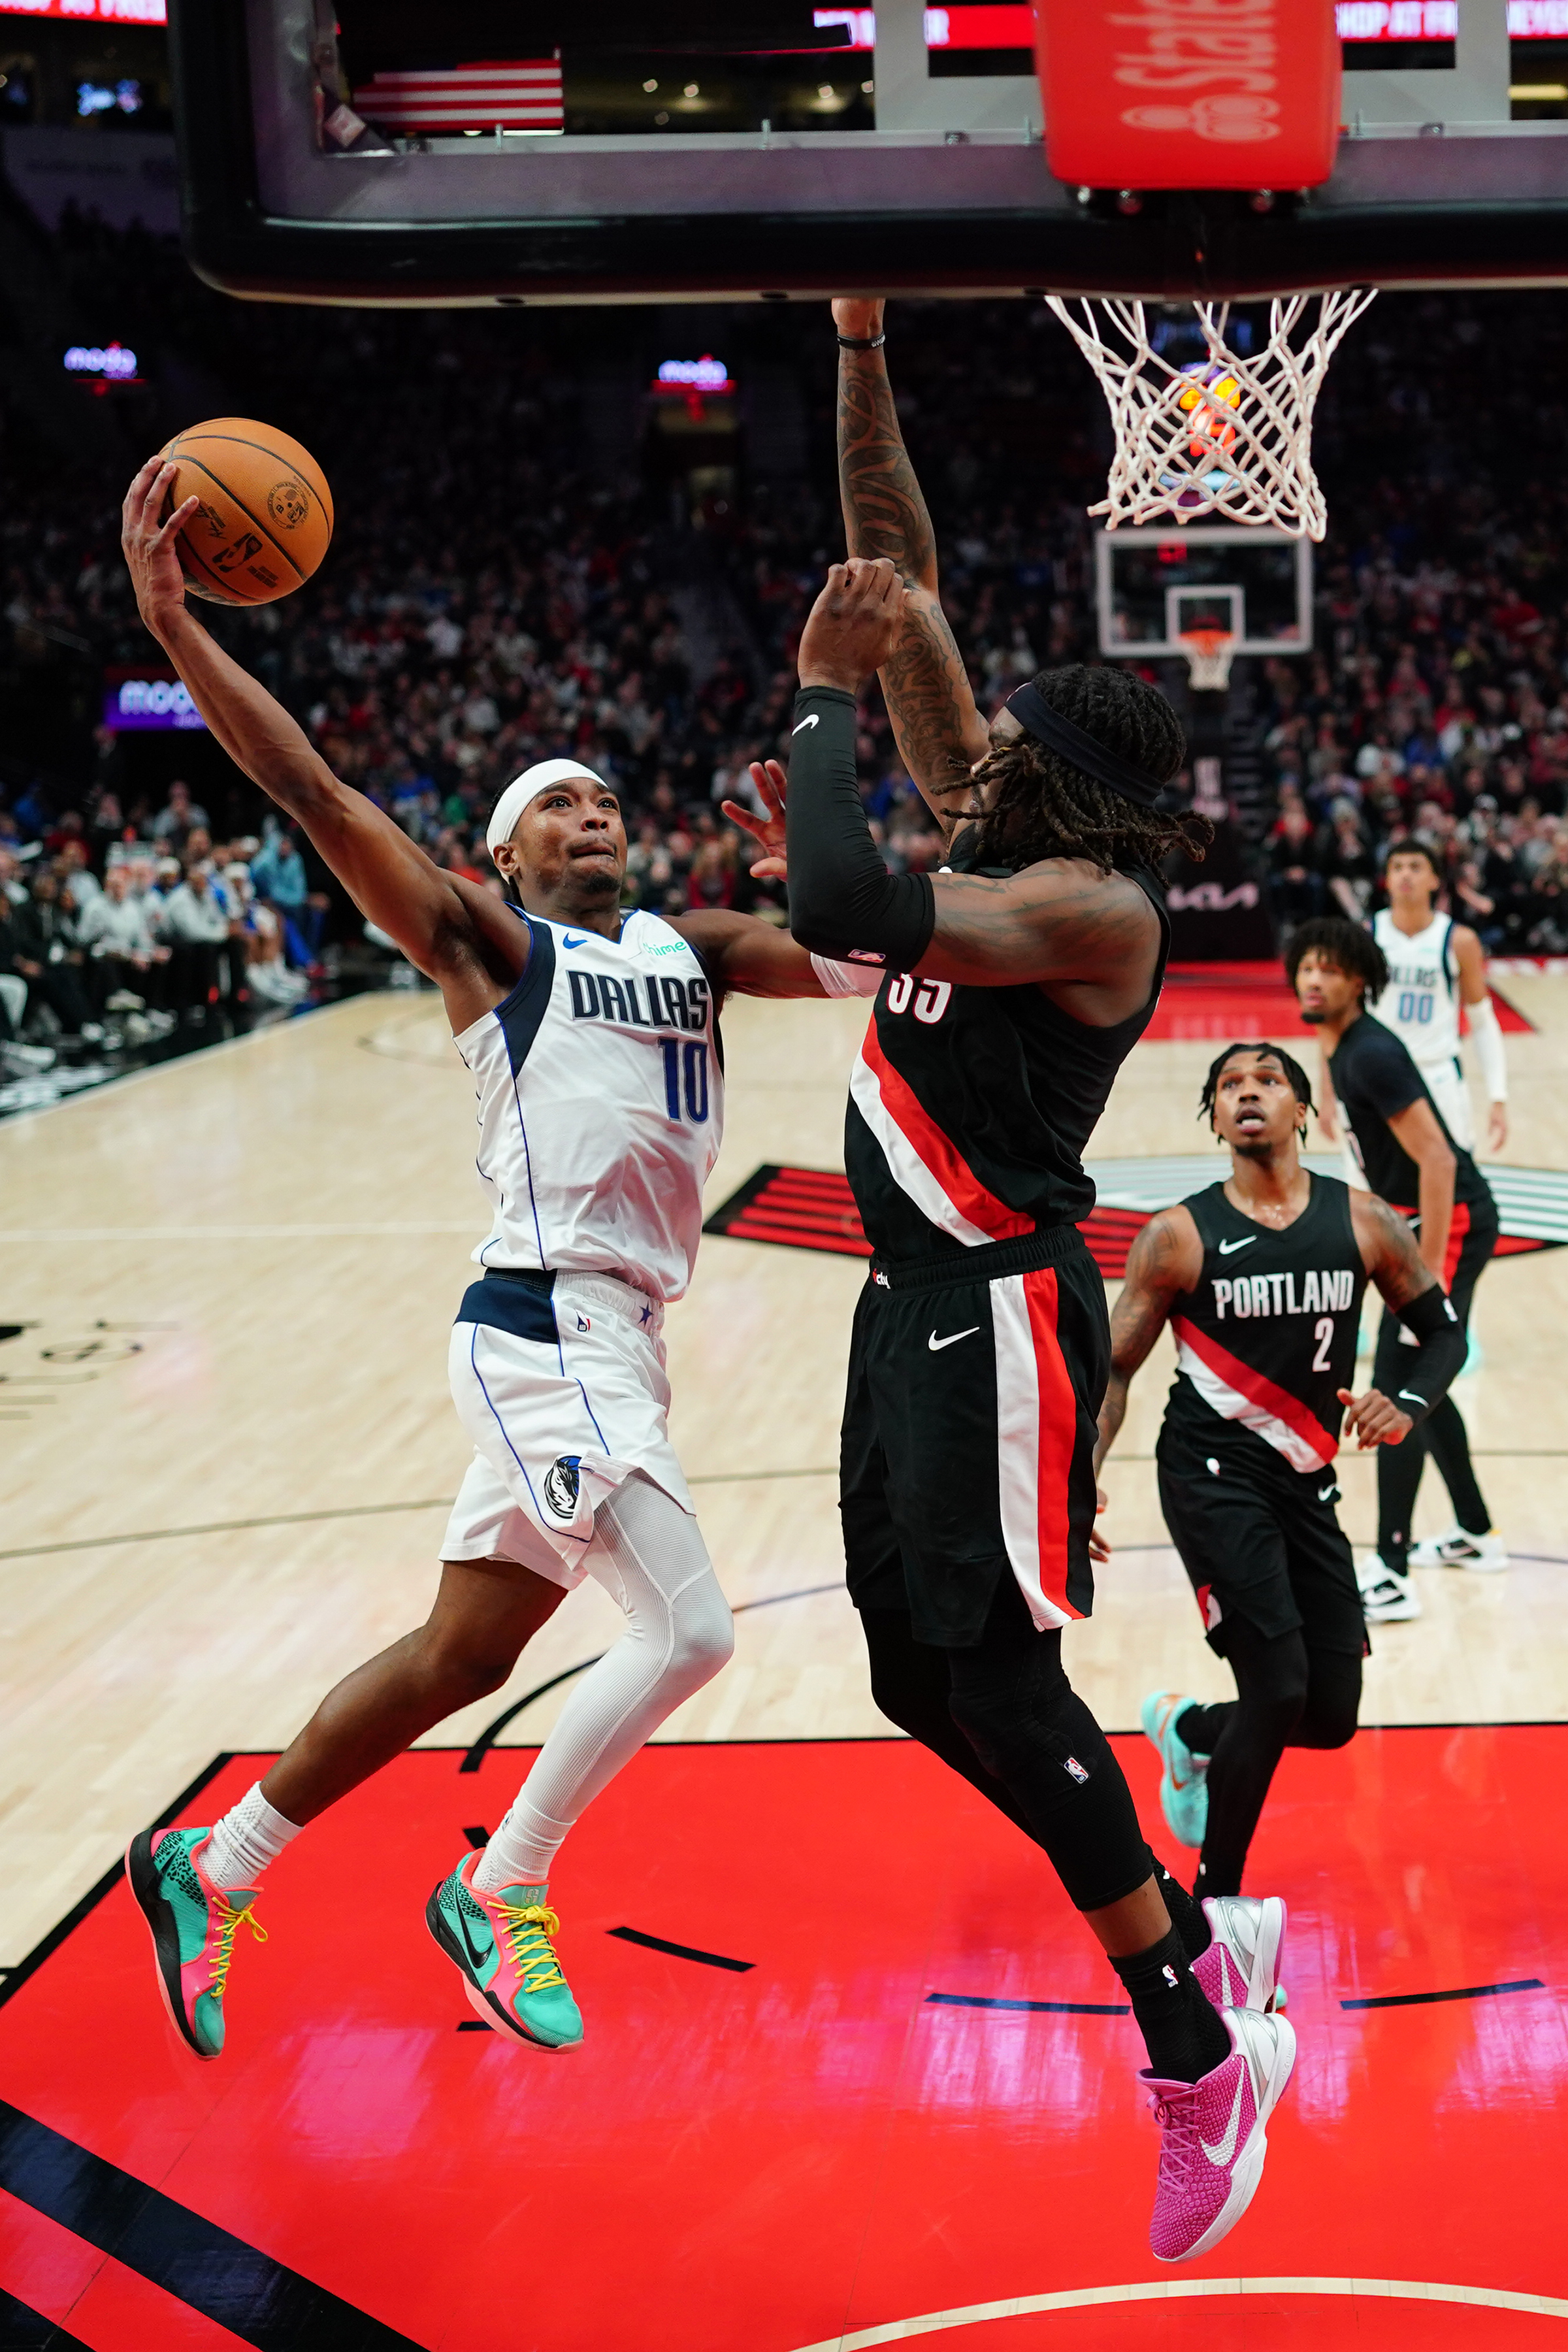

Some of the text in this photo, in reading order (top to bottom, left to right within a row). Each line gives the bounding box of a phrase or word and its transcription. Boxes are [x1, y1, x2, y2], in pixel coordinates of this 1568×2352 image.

[566, 970, 709, 1032] DALLAS
[1398, 990, 1435, 1025] 00
[657, 1037, 710, 1126] 10
[1211, 1269, 1355, 1320] PORTLAND
[1312, 1317, 1334, 1372] 2
